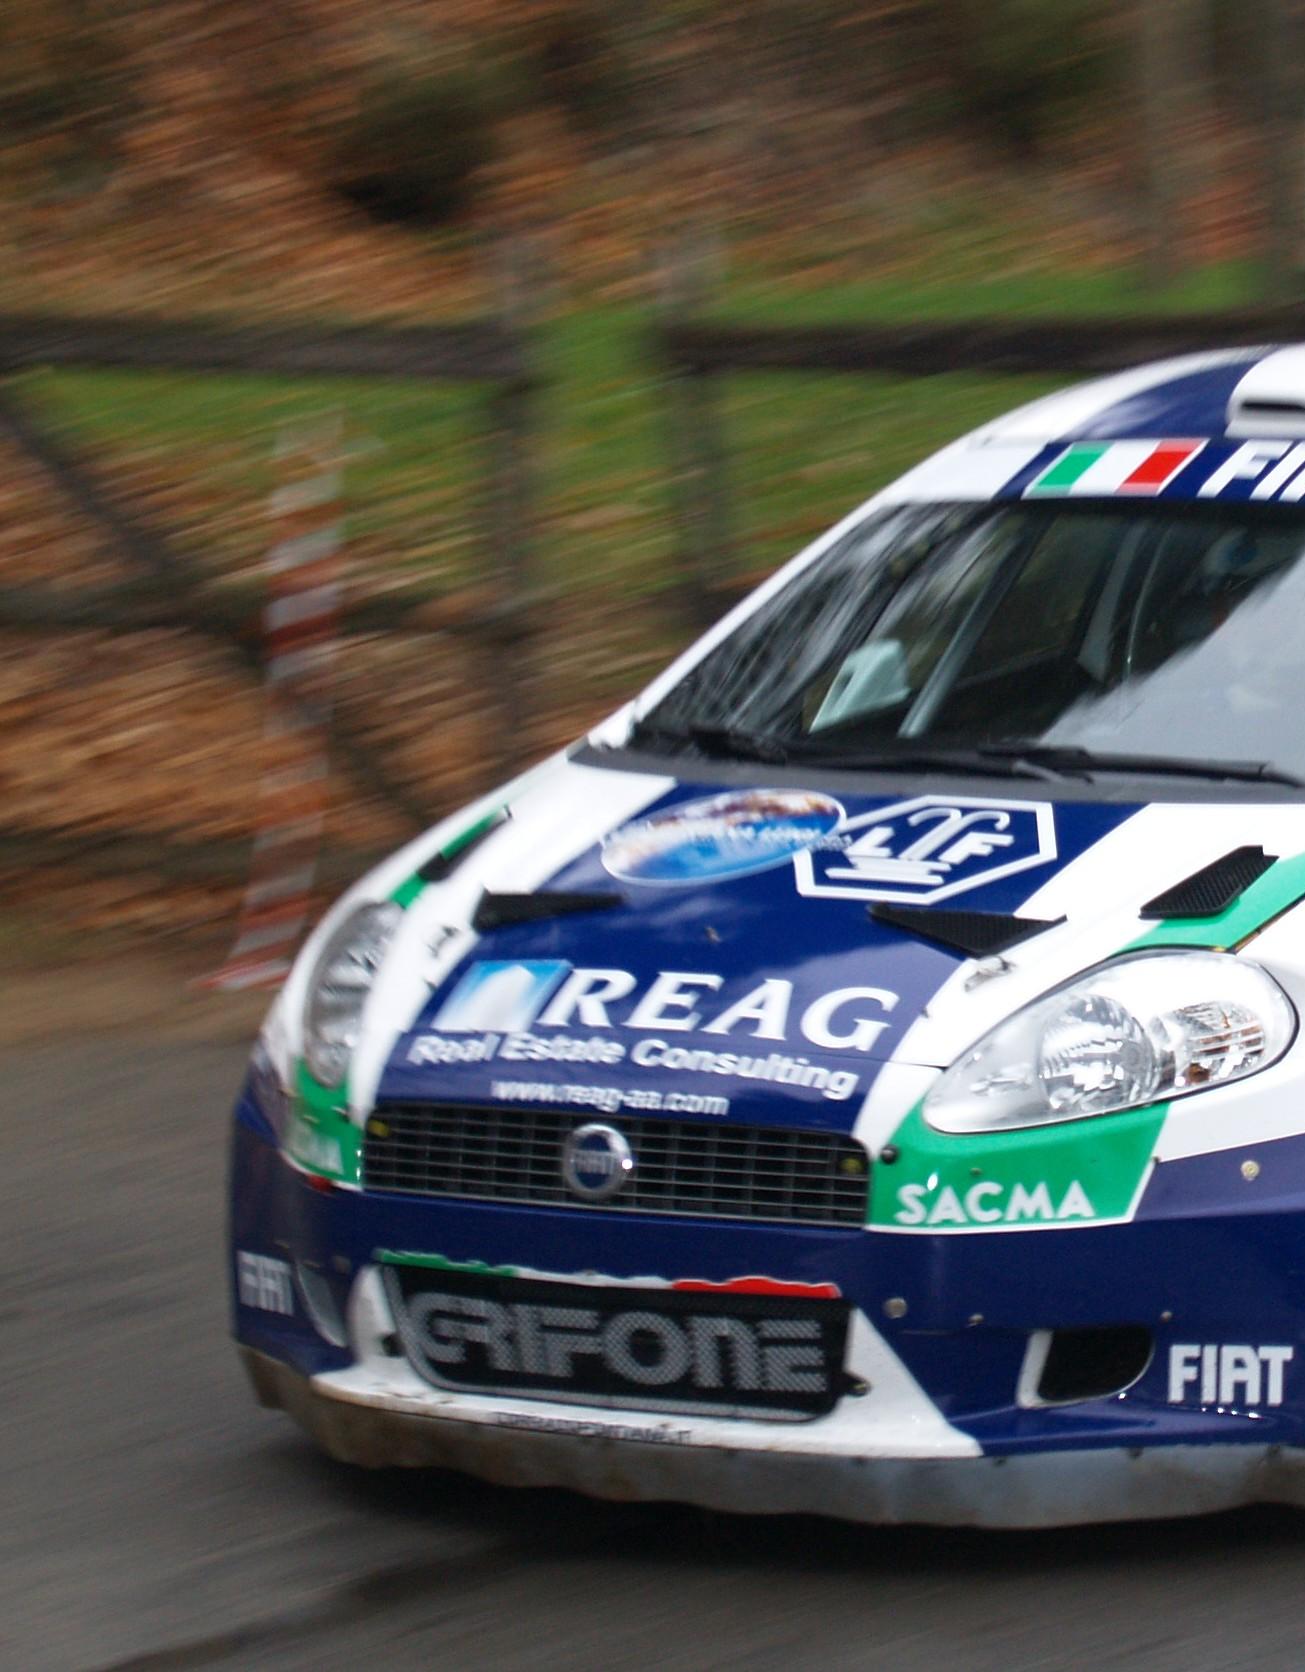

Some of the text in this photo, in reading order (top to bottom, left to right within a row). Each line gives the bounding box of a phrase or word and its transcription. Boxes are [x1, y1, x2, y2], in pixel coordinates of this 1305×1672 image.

[538, 967, 900, 1052] REAG
[407, 1032, 860, 1101] Real Estate Consulting
[893, 1179, 1096, 1226] SACMA
[404, 1292, 828, 1394] GRIFONE
[1167, 1343, 1295, 1408] FIAT
